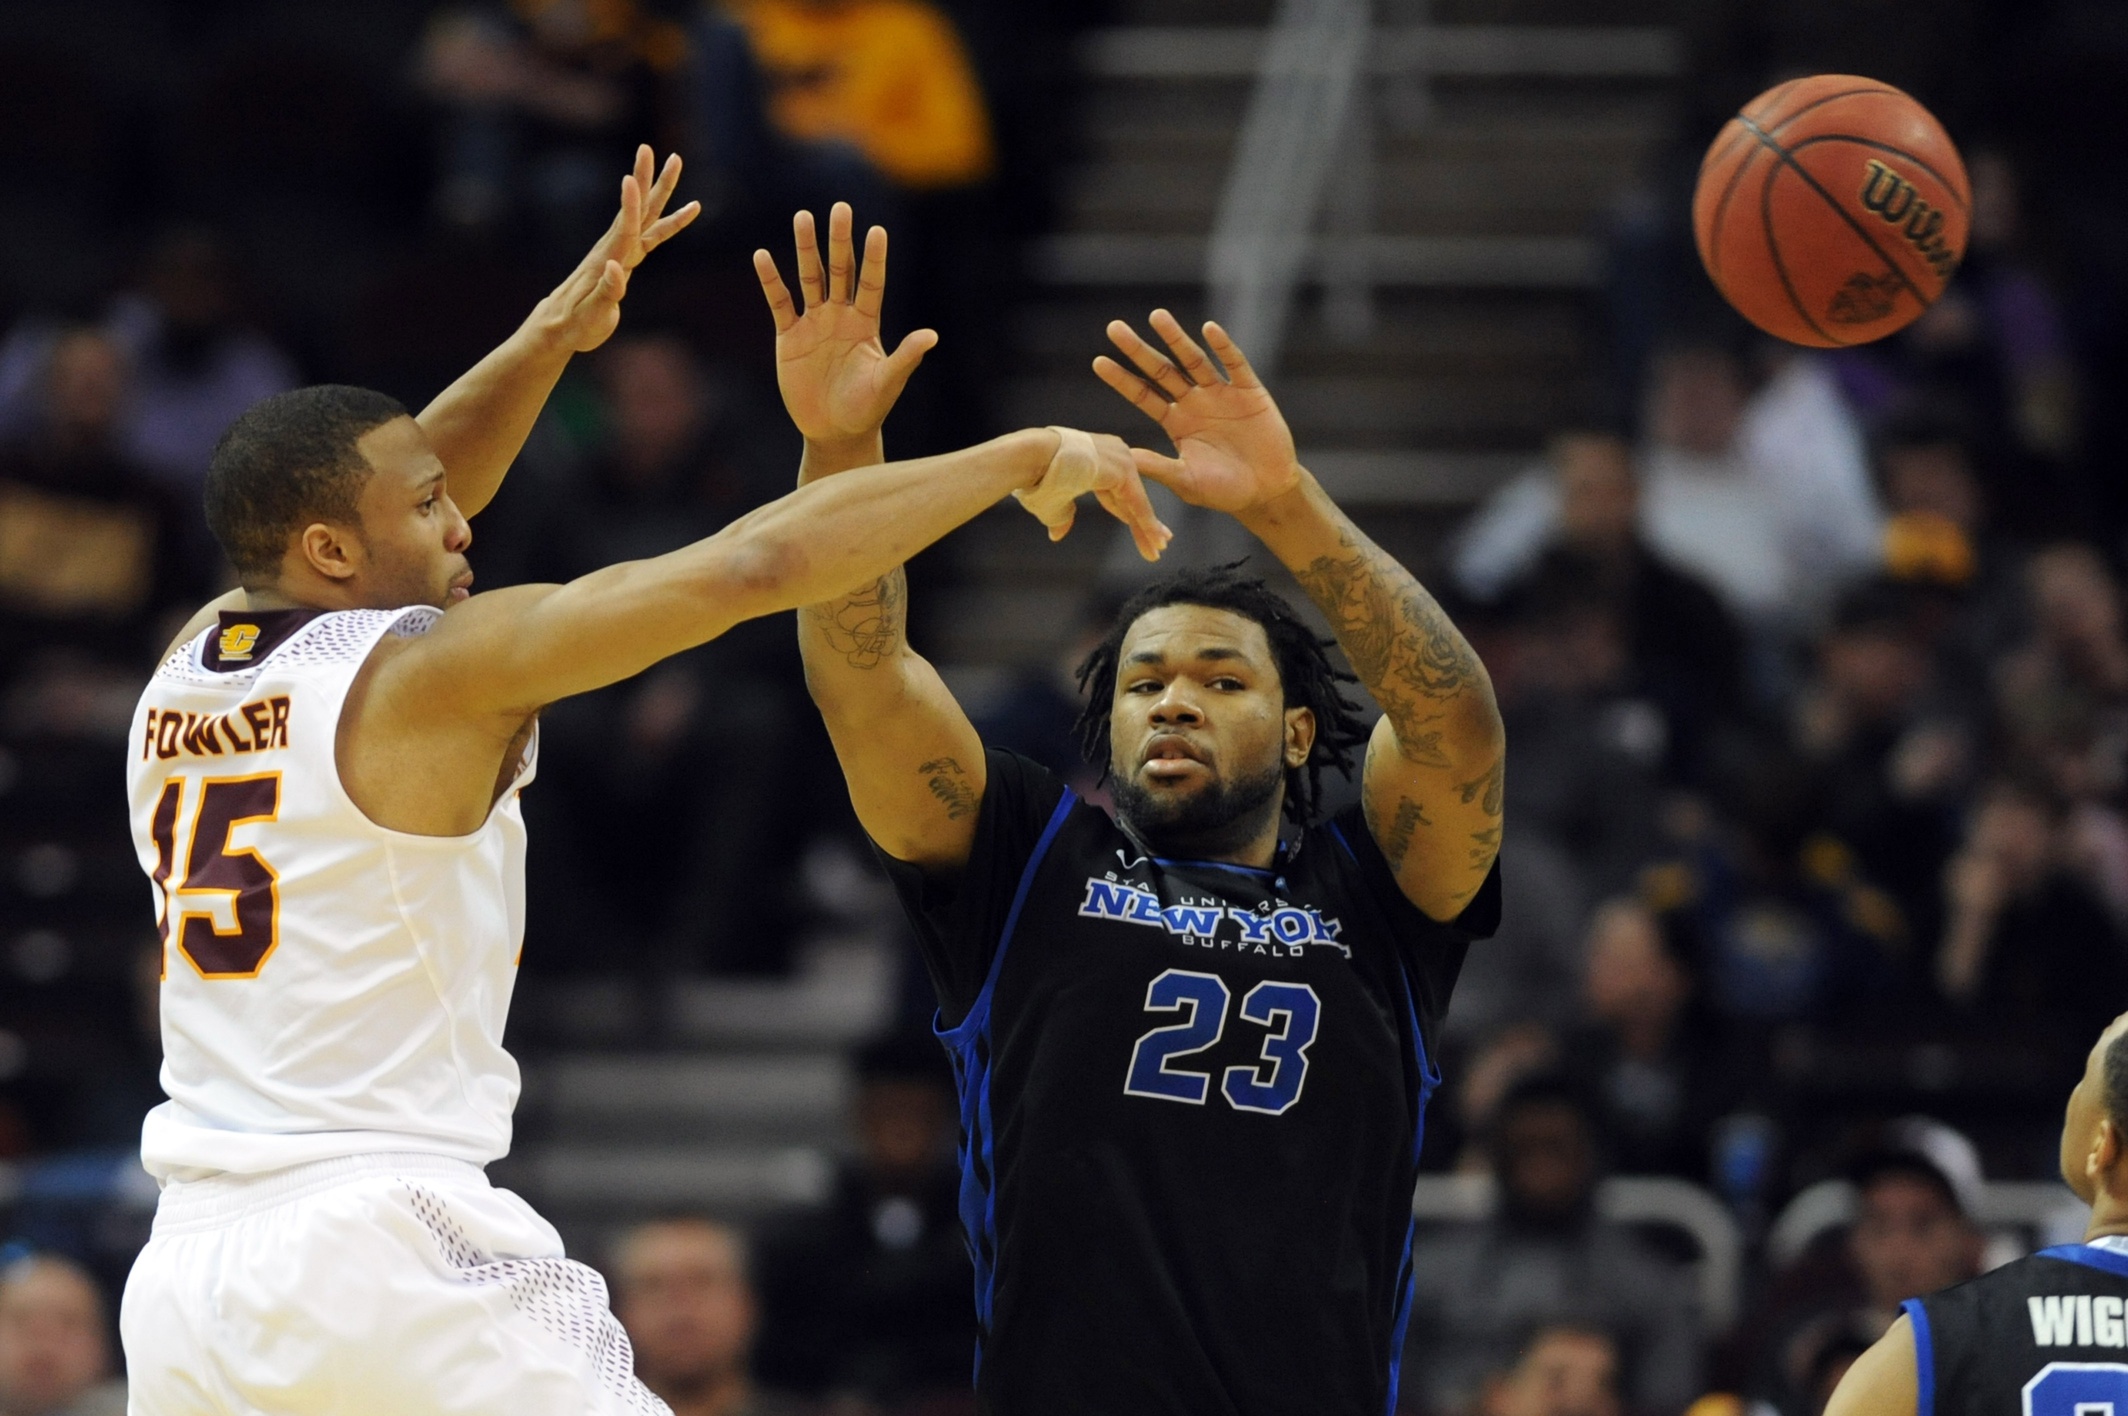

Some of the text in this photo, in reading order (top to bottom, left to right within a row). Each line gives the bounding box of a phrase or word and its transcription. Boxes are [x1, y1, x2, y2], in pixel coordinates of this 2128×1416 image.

[1862, 159, 1953, 276] Wils
[143, 695, 291, 762] FOWLER
[150, 770, 283, 981] 15
[1078, 877, 1225, 938] NEW
[1182, 934, 1304, 957] BUFFALO
[1123, 968, 1321, 1116] 23
[2027, 1295, 2128, 1348] WIG
